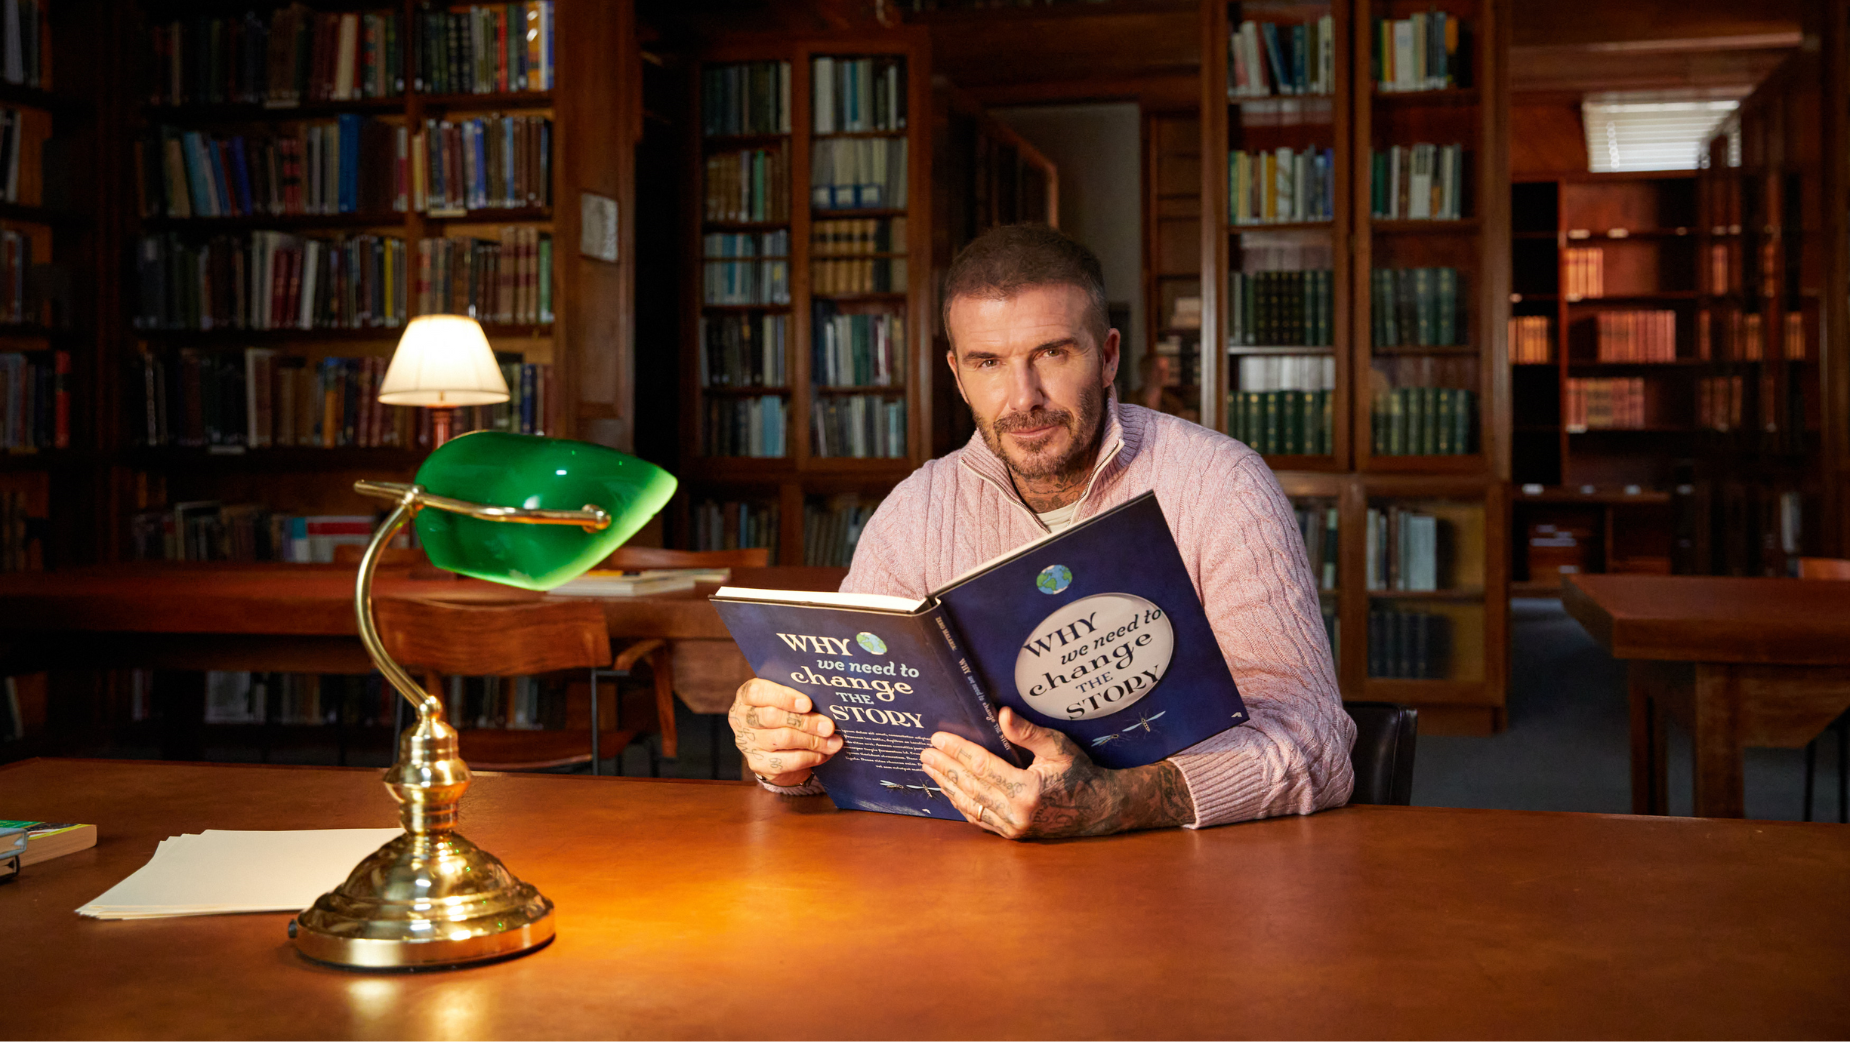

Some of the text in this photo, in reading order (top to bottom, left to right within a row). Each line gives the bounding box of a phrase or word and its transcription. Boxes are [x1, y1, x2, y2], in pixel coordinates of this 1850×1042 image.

[776, 633, 853, 656] WHY
[1022, 611, 1098, 658] WHY
[1060, 608, 1162, 665] we need to
[816, 658, 920, 678] we need to
[1028, 633, 1153, 697] change
[790, 665, 914, 702] change
[835, 691, 875, 705] THE
[1066, 664, 1161, 720] STORY
[1075, 671, 1114, 694] THE
[829, 704, 925, 729] STORY
